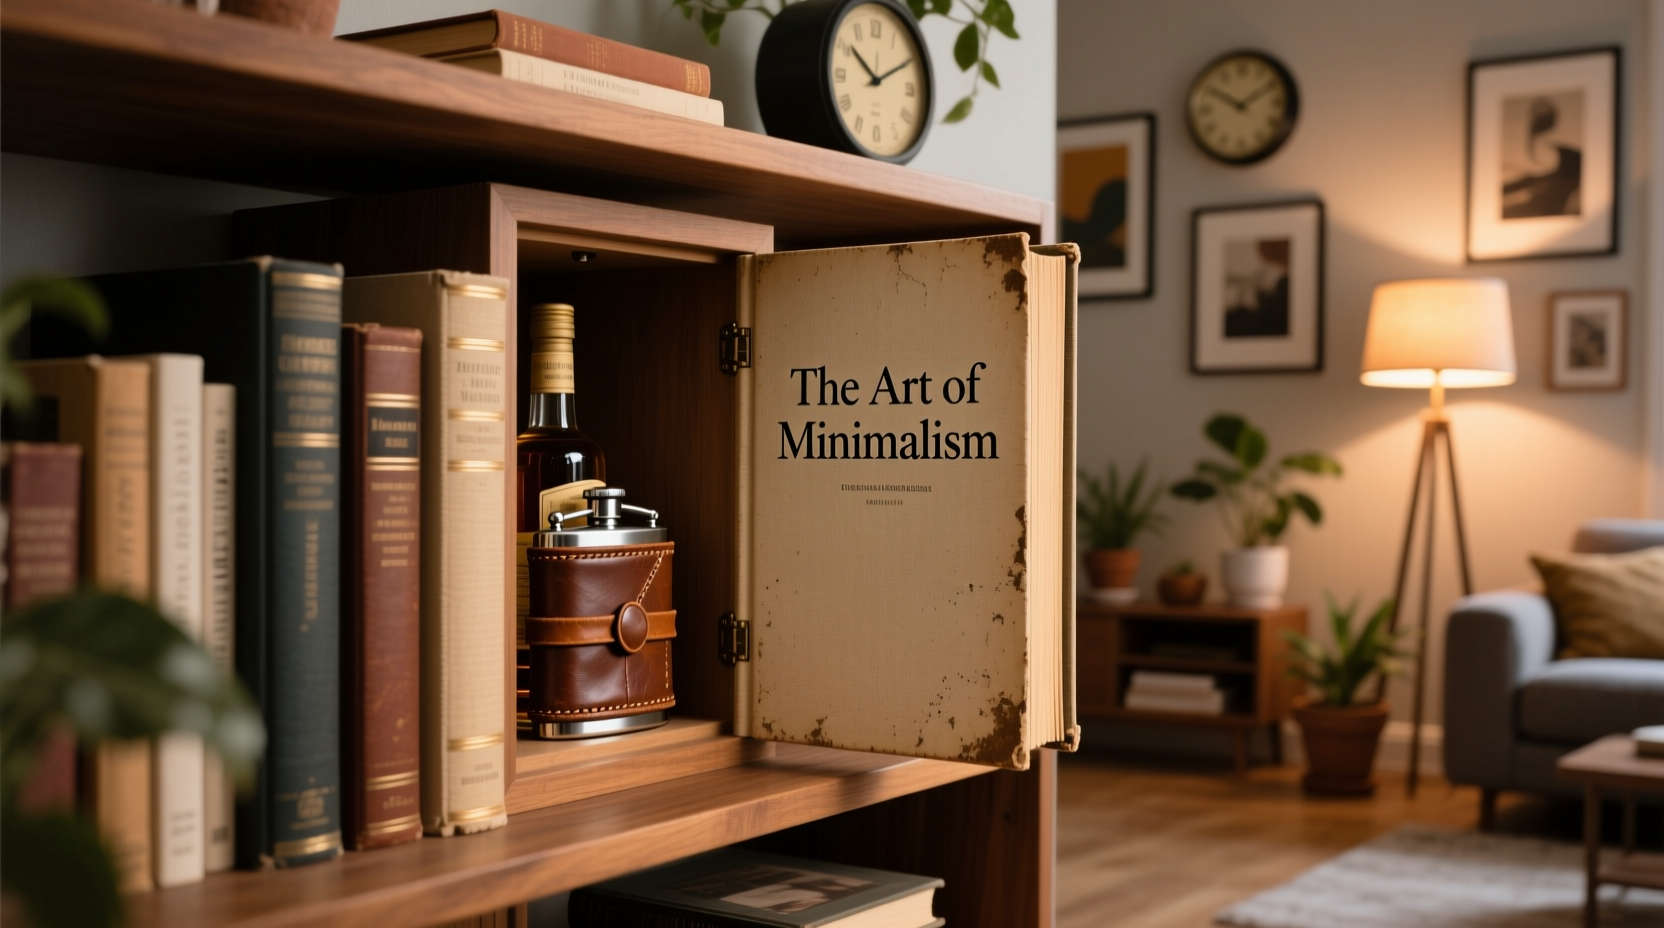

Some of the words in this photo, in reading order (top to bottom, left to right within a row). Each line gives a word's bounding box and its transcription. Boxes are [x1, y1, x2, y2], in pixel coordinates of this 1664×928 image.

[790, 365, 860, 406] The
[868, 365, 933, 406] Art
[942, 361, 987, 405] of
[777, 418, 1000, 460] Minimalism
